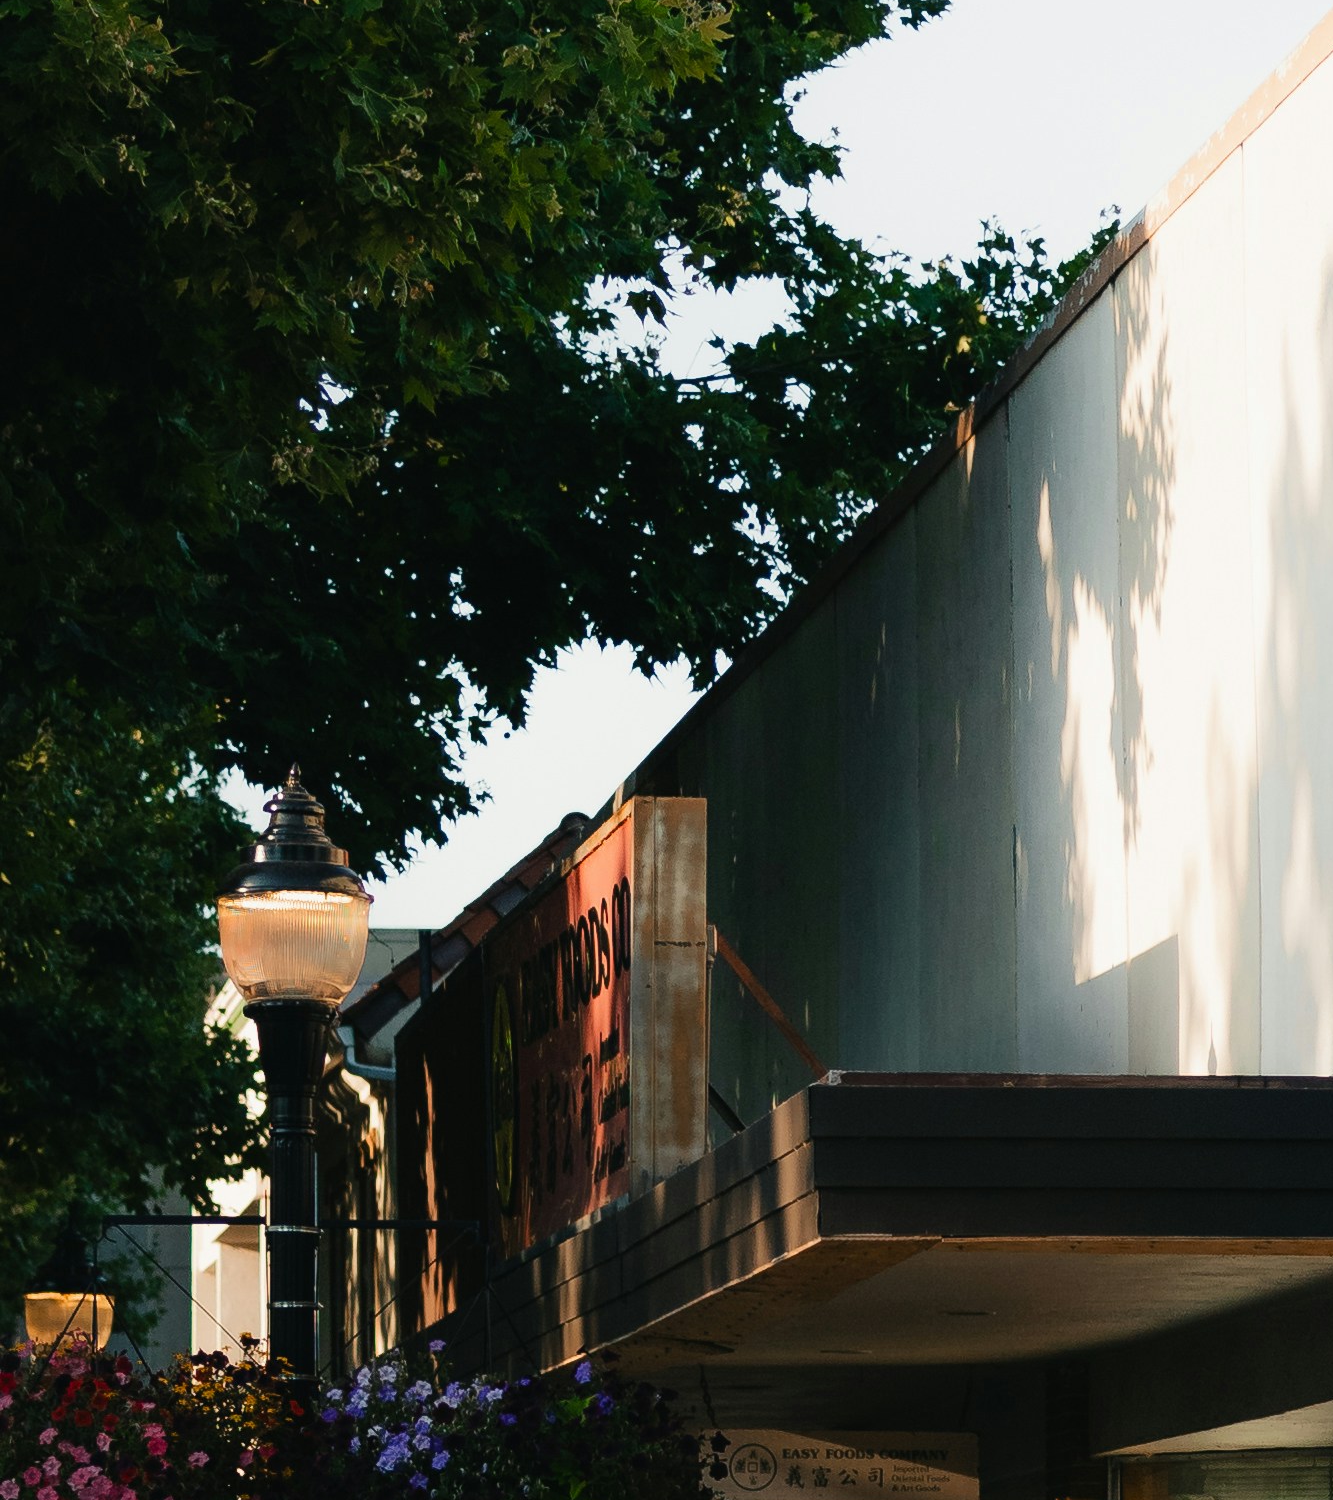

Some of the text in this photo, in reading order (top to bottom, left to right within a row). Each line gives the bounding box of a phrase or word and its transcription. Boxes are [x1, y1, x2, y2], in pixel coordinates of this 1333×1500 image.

[782, 1448, 950, 1461] EASY FOODS COMPANY
[785, 1465, 886, 1489] 義富公司
